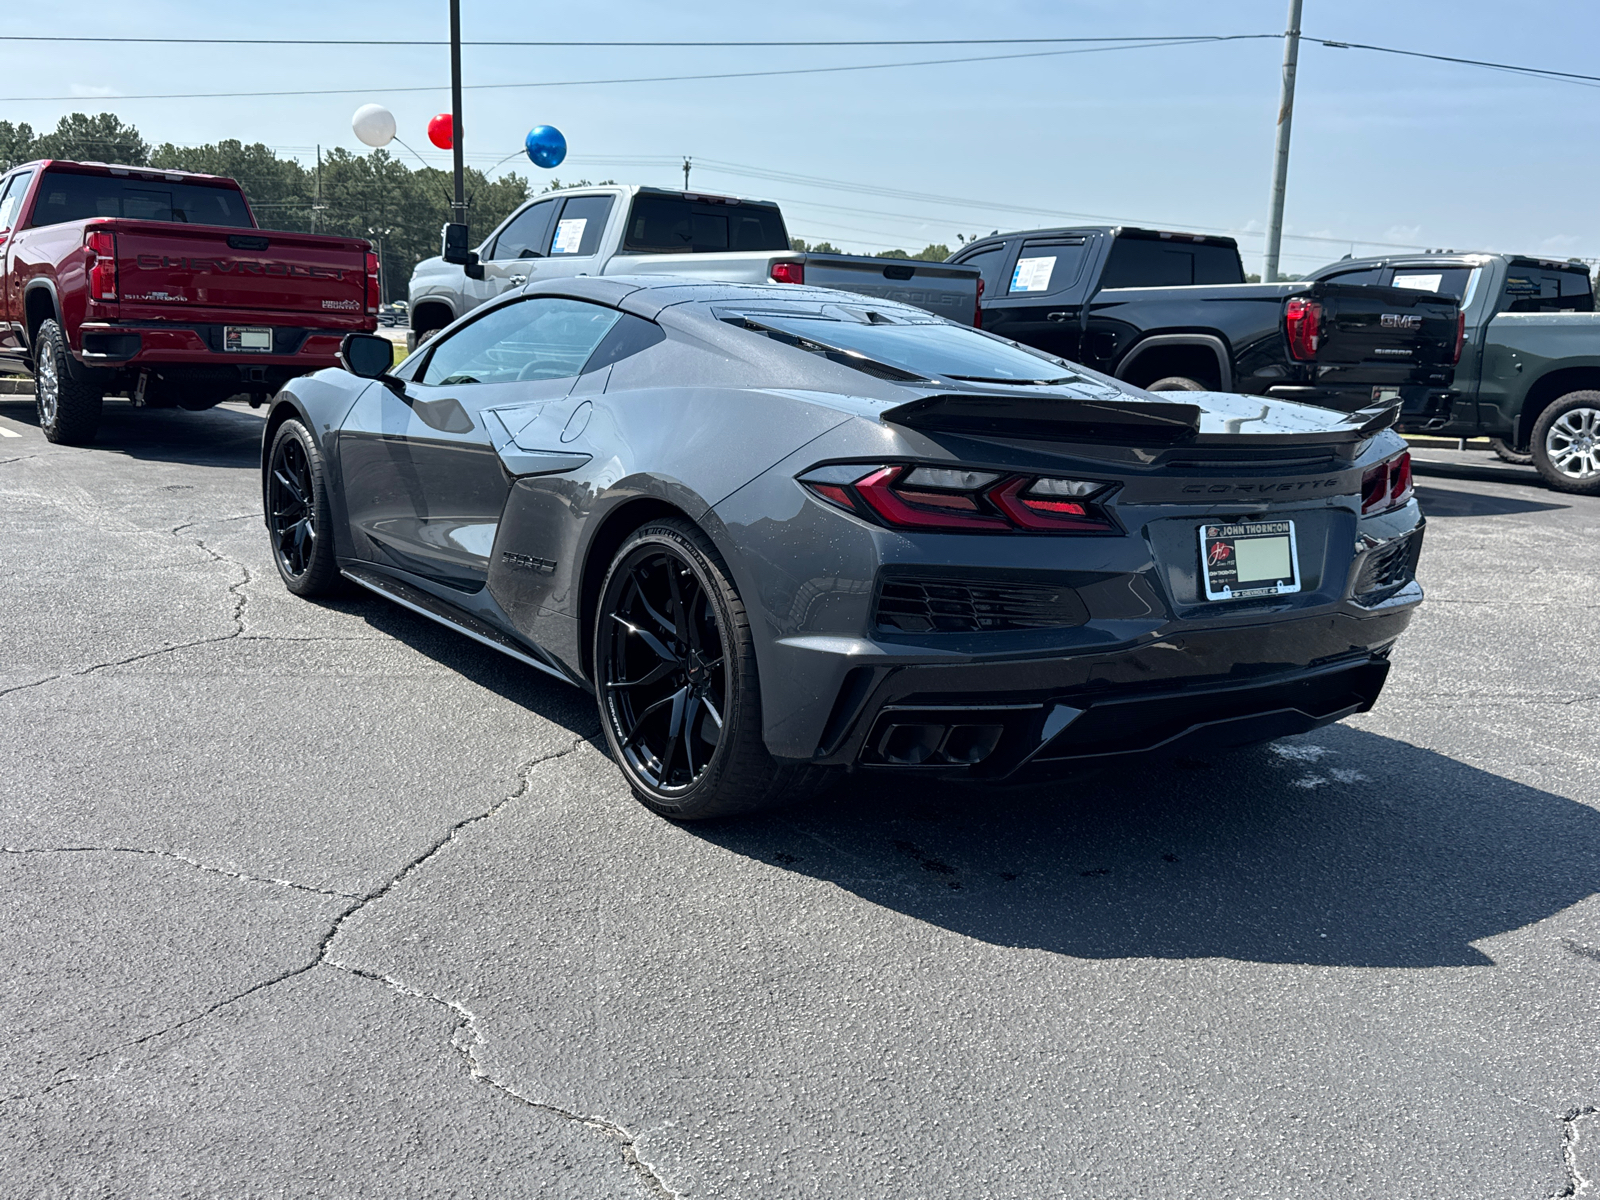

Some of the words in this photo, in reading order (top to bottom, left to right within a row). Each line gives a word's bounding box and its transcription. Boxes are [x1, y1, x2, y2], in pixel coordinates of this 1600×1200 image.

[137, 254, 350, 281] CHEVROLET
[1381, 314, 1421, 329] GMC
[1182, 477, 1338, 494] CORVETTE
[646, 527, 683, 543] MICHELIN
[1223, 525, 1245, 536] JOHN
[1245, 523, 1289, 535] THORNTON
[1241, 588, 1269, 597] CHEVROLET
[608, 696, 623, 737] CORVETTE
